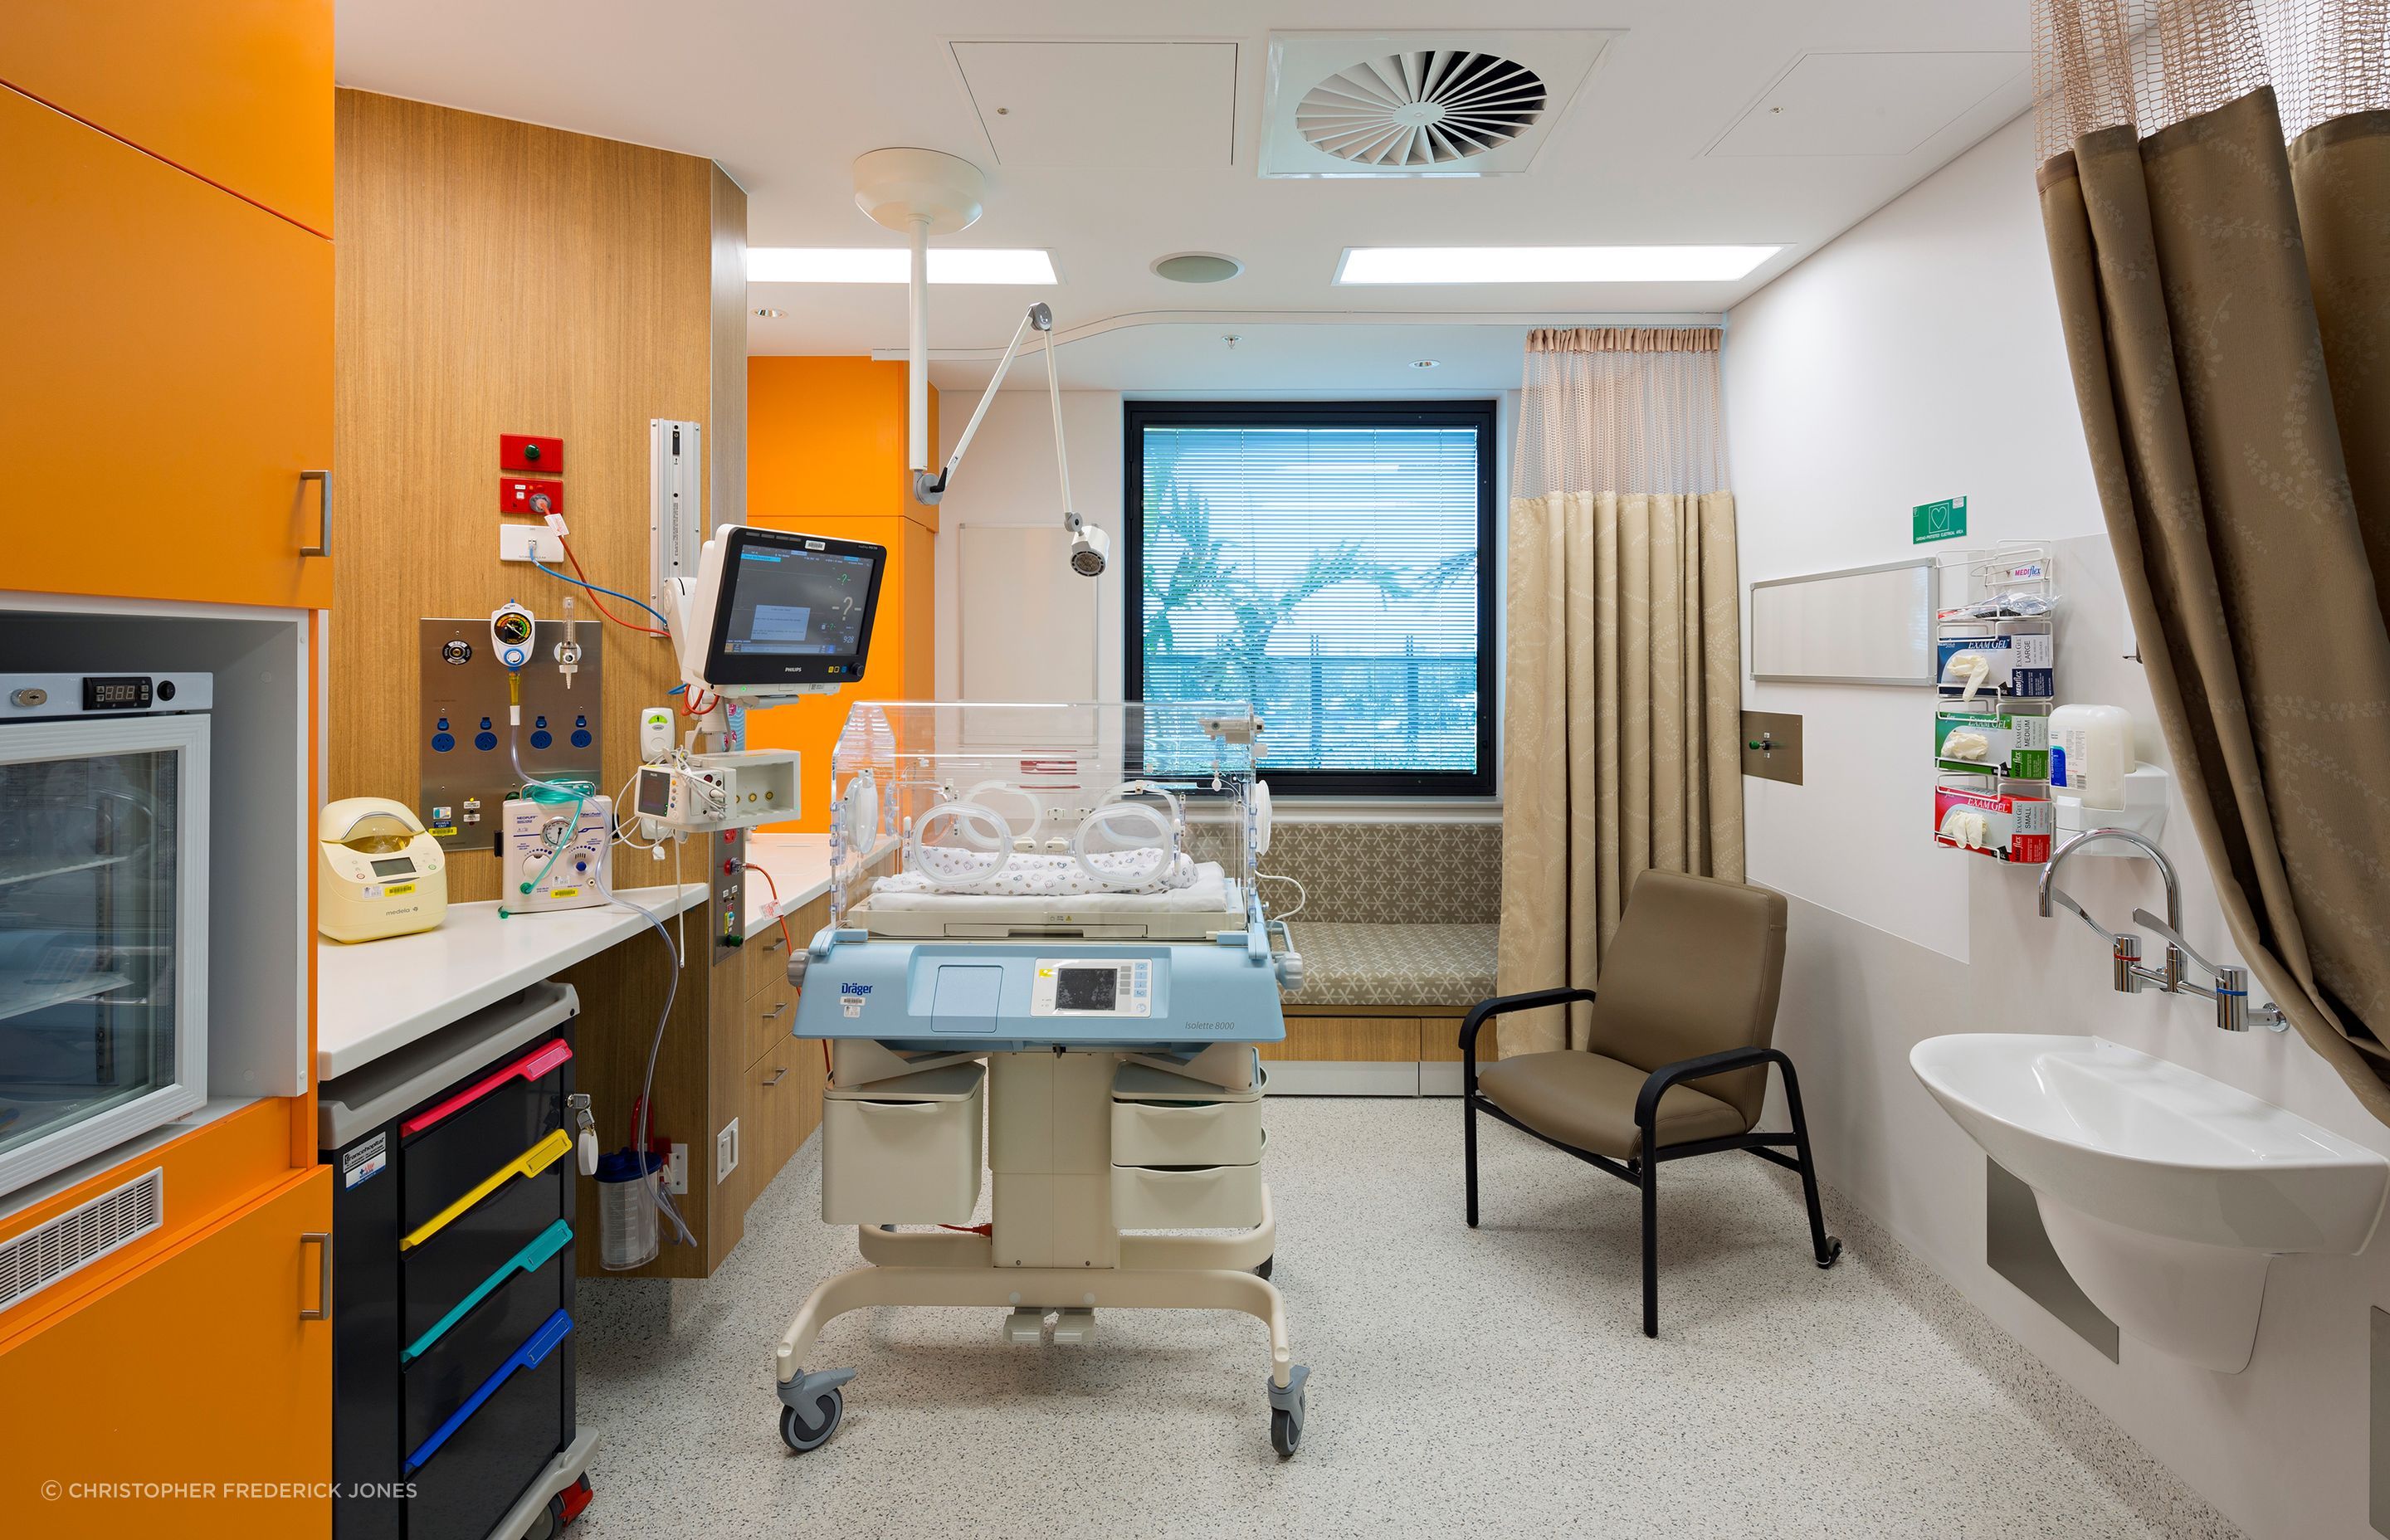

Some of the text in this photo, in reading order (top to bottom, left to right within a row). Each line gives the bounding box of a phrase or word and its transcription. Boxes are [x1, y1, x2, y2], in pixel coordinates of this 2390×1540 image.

[1968, 641, 1990, 649] EXAM
[1967, 797, 1990, 809] EXAM
[385, 907, 410, 916] medela
[841, 982, 873, 996] Dräger
[1184, 1021, 1235, 1030] Isolette 8000
